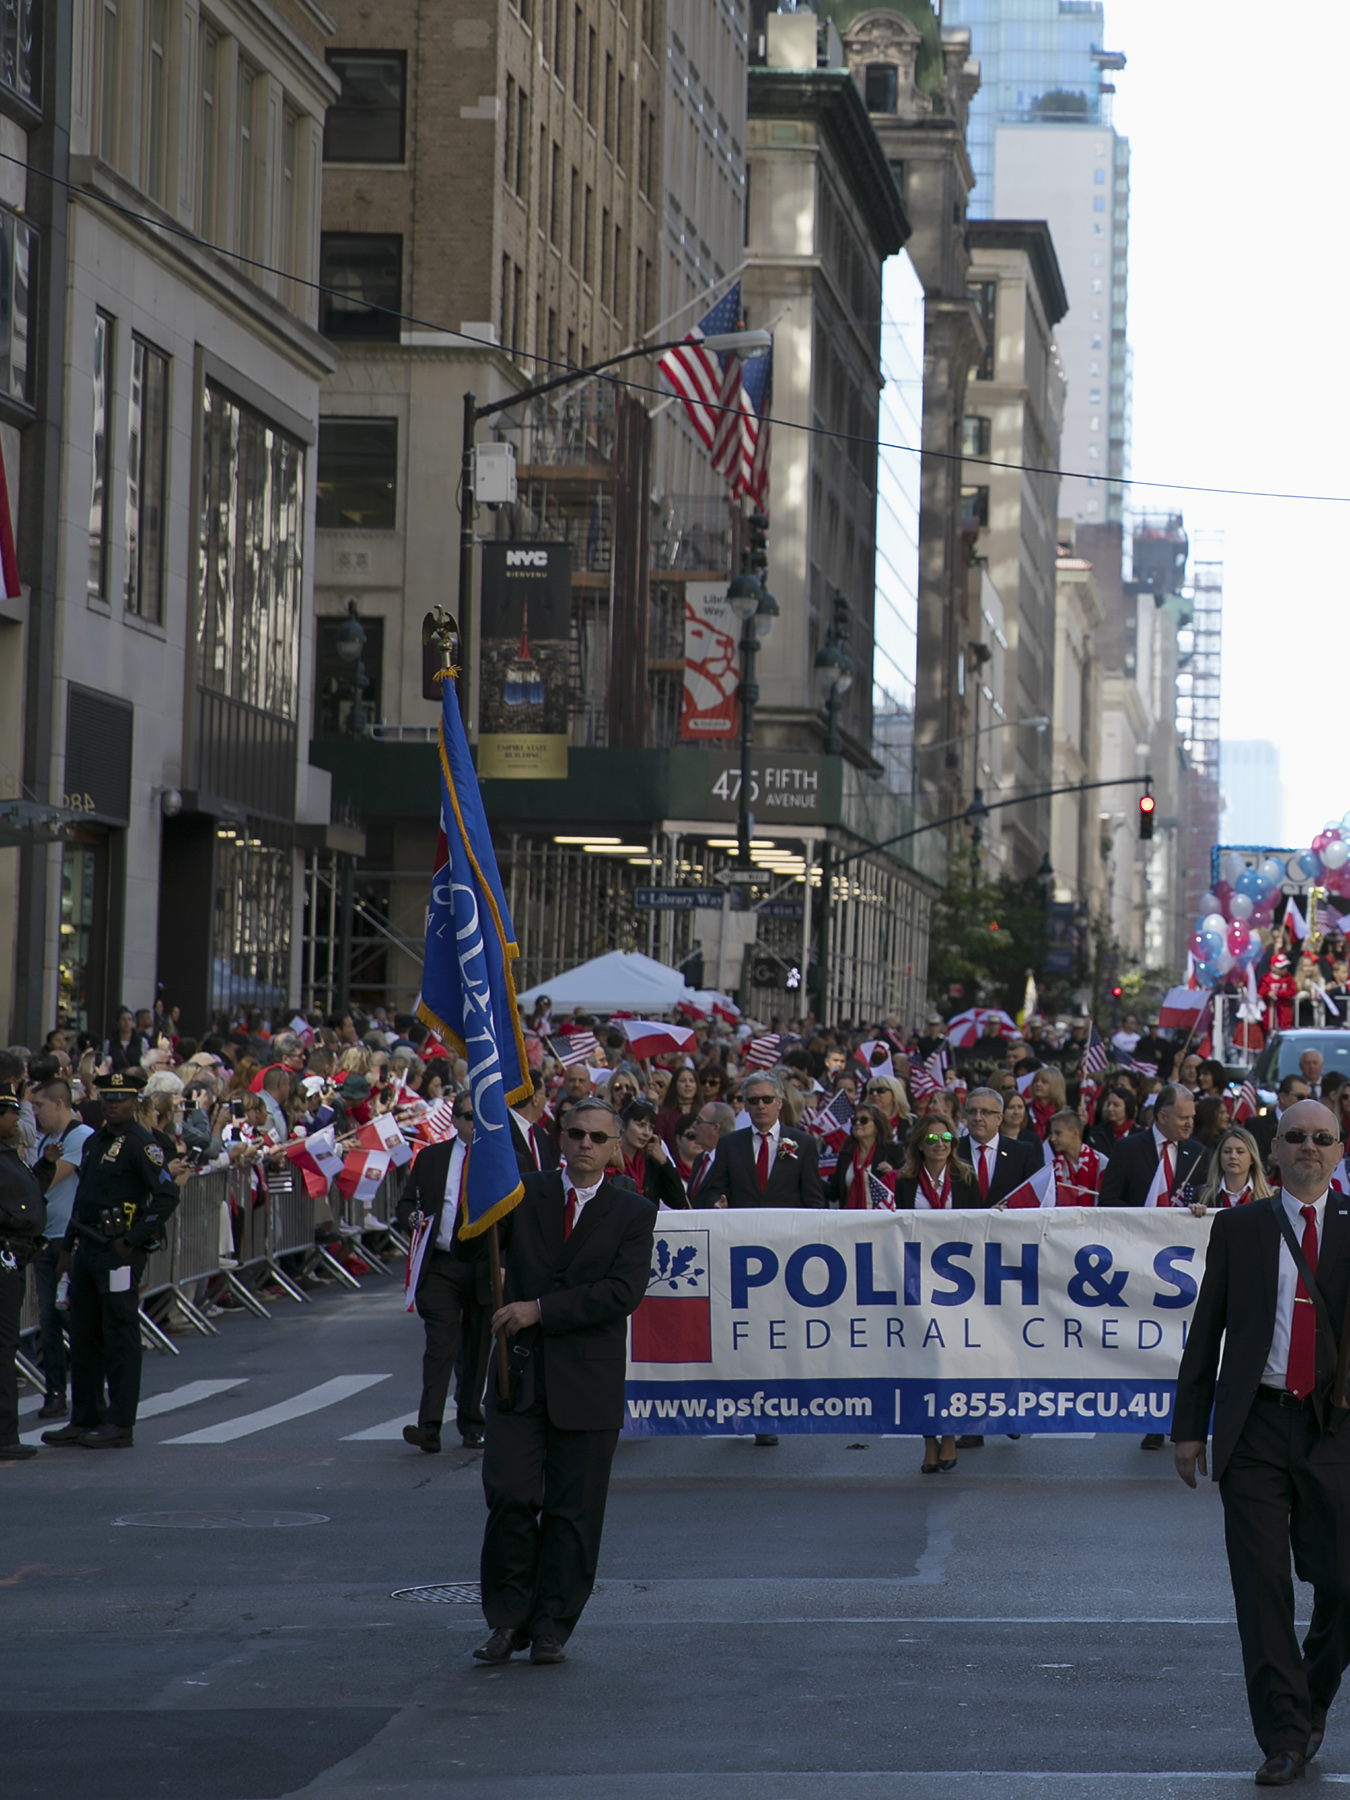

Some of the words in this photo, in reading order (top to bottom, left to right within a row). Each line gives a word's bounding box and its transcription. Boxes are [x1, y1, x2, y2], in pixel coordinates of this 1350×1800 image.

[506, 550, 548, 566] NYC
[711, 769, 759, 802] 475
[764, 767, 818, 789] FIFTH
[765, 793, 817, 808] AVENUE
[650, 892, 695, 908] Library
[696, 893, 723, 908] Way
[730, 1242, 1039, 1309] POLISH
[1067, 1243, 1129, 1308] &
[733, 1317, 981, 1350] FEDERAL
[1022, 1317, 1187, 1350] CREDI
[628, 1391, 873, 1423] www.psfcu.com
[923, 1391, 1170, 1418] 1.855.PSFCU.4U
